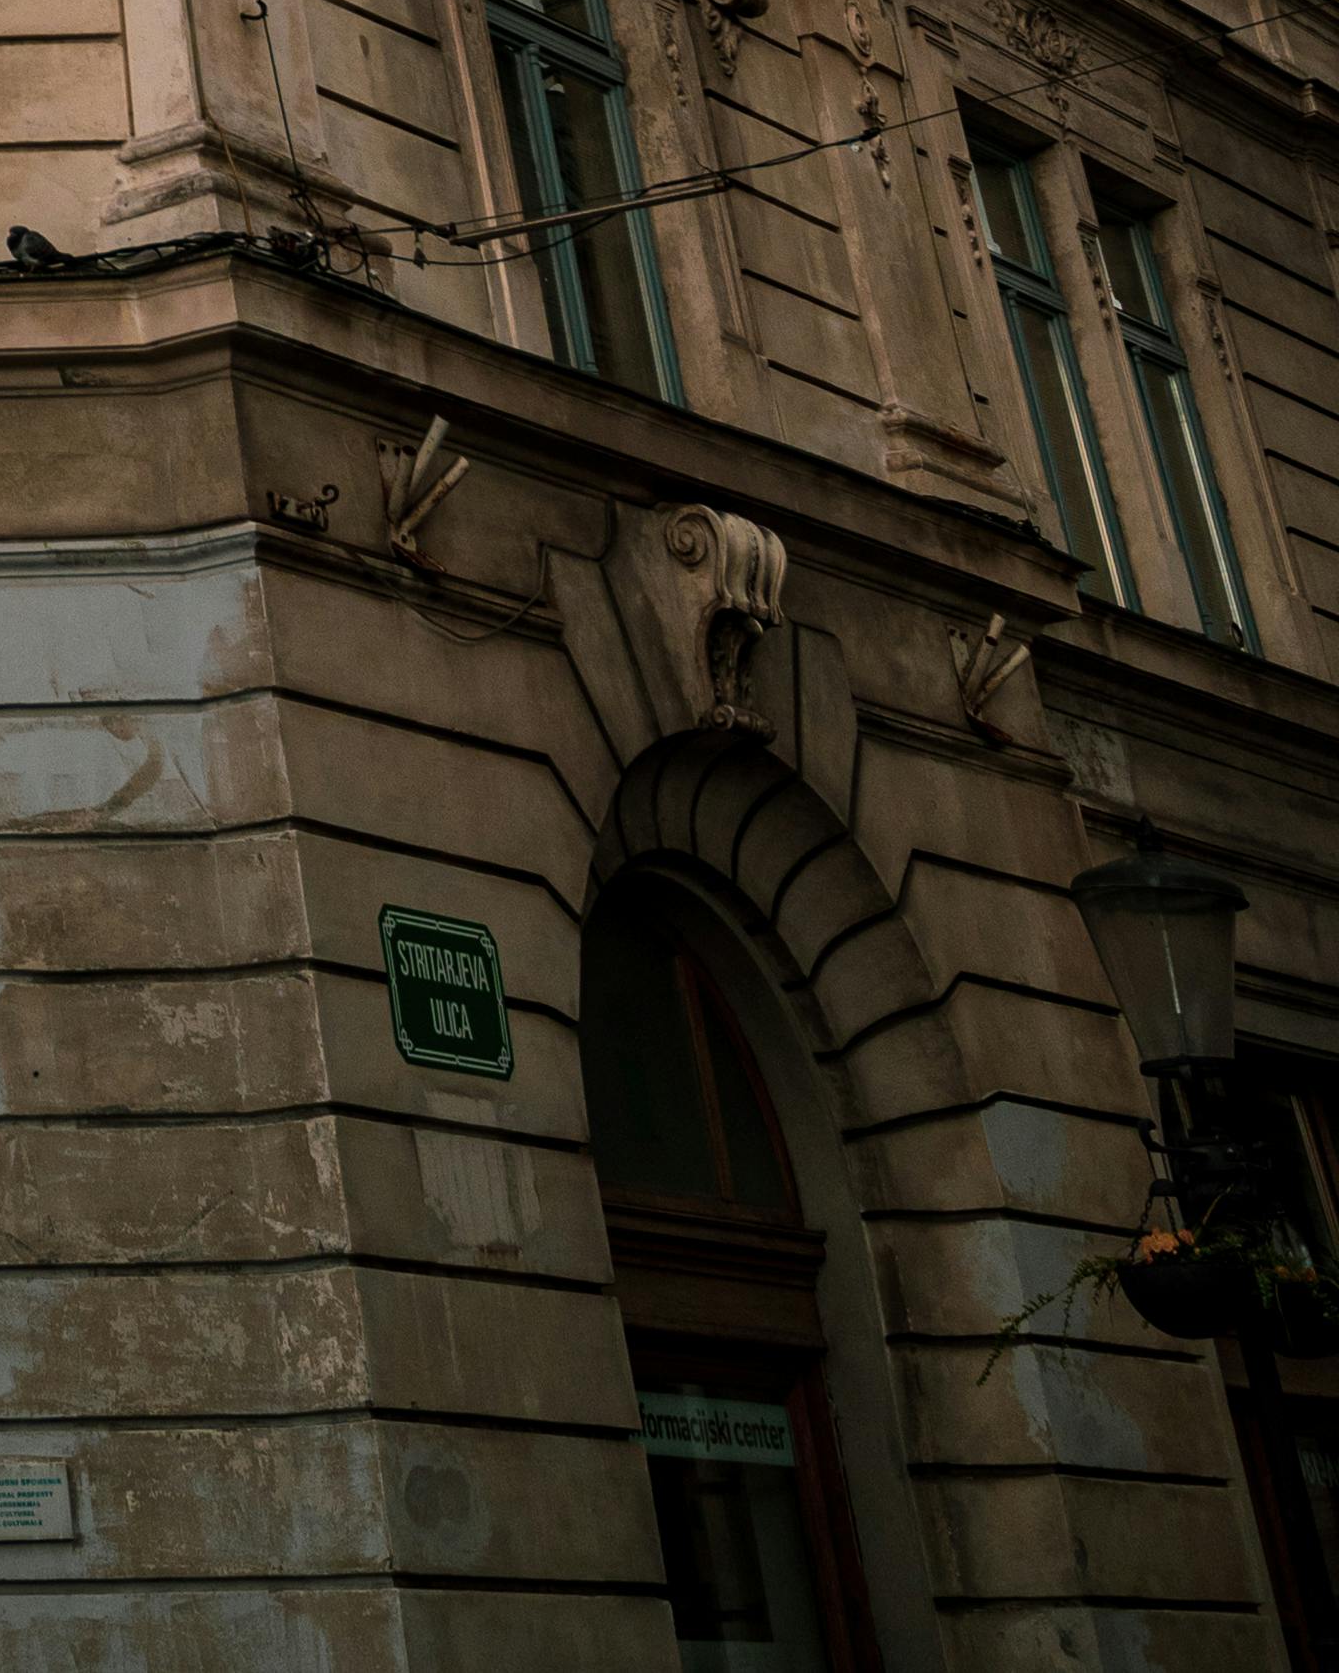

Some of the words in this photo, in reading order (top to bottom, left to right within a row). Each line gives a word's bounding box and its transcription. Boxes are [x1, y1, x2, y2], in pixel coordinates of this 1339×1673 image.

[397, 939, 491, 993] STRITARJEVA
[429, 997, 474, 1041] ULICA
[632, 1402, 732, 1452] formacijski
[734, 1417, 786, 1450] center
